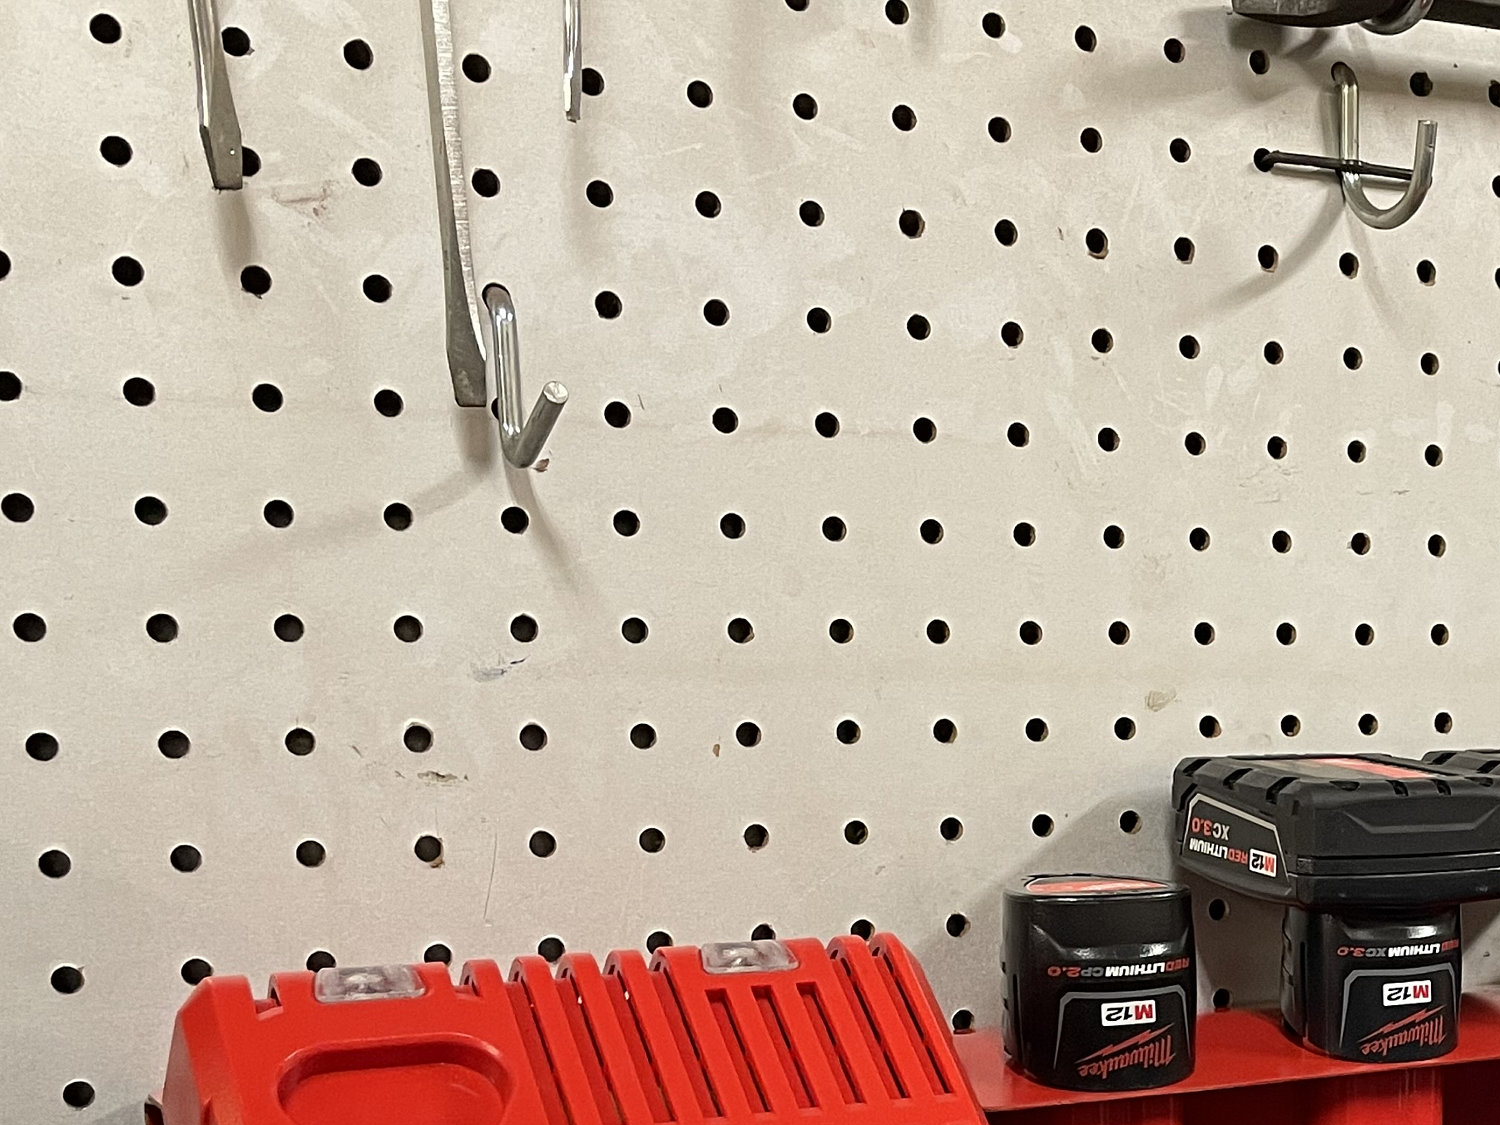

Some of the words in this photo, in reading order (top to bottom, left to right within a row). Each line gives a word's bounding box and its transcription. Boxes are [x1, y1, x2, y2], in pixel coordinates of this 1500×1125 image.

[1191, 817, 1230, 841] XC3.0
[1251, 852, 1275, 874] M12
[1336, 946, 1387, 958] XC3.0
[1047, 965, 1105, 978] CP2.0
[1386, 984, 1429, 1002] M12
[1105, 1003, 1154, 1022] M12
[1360, 1014, 1447, 1057] Milwaukee
[1076, 1034, 1177, 1080] Milwaukee
